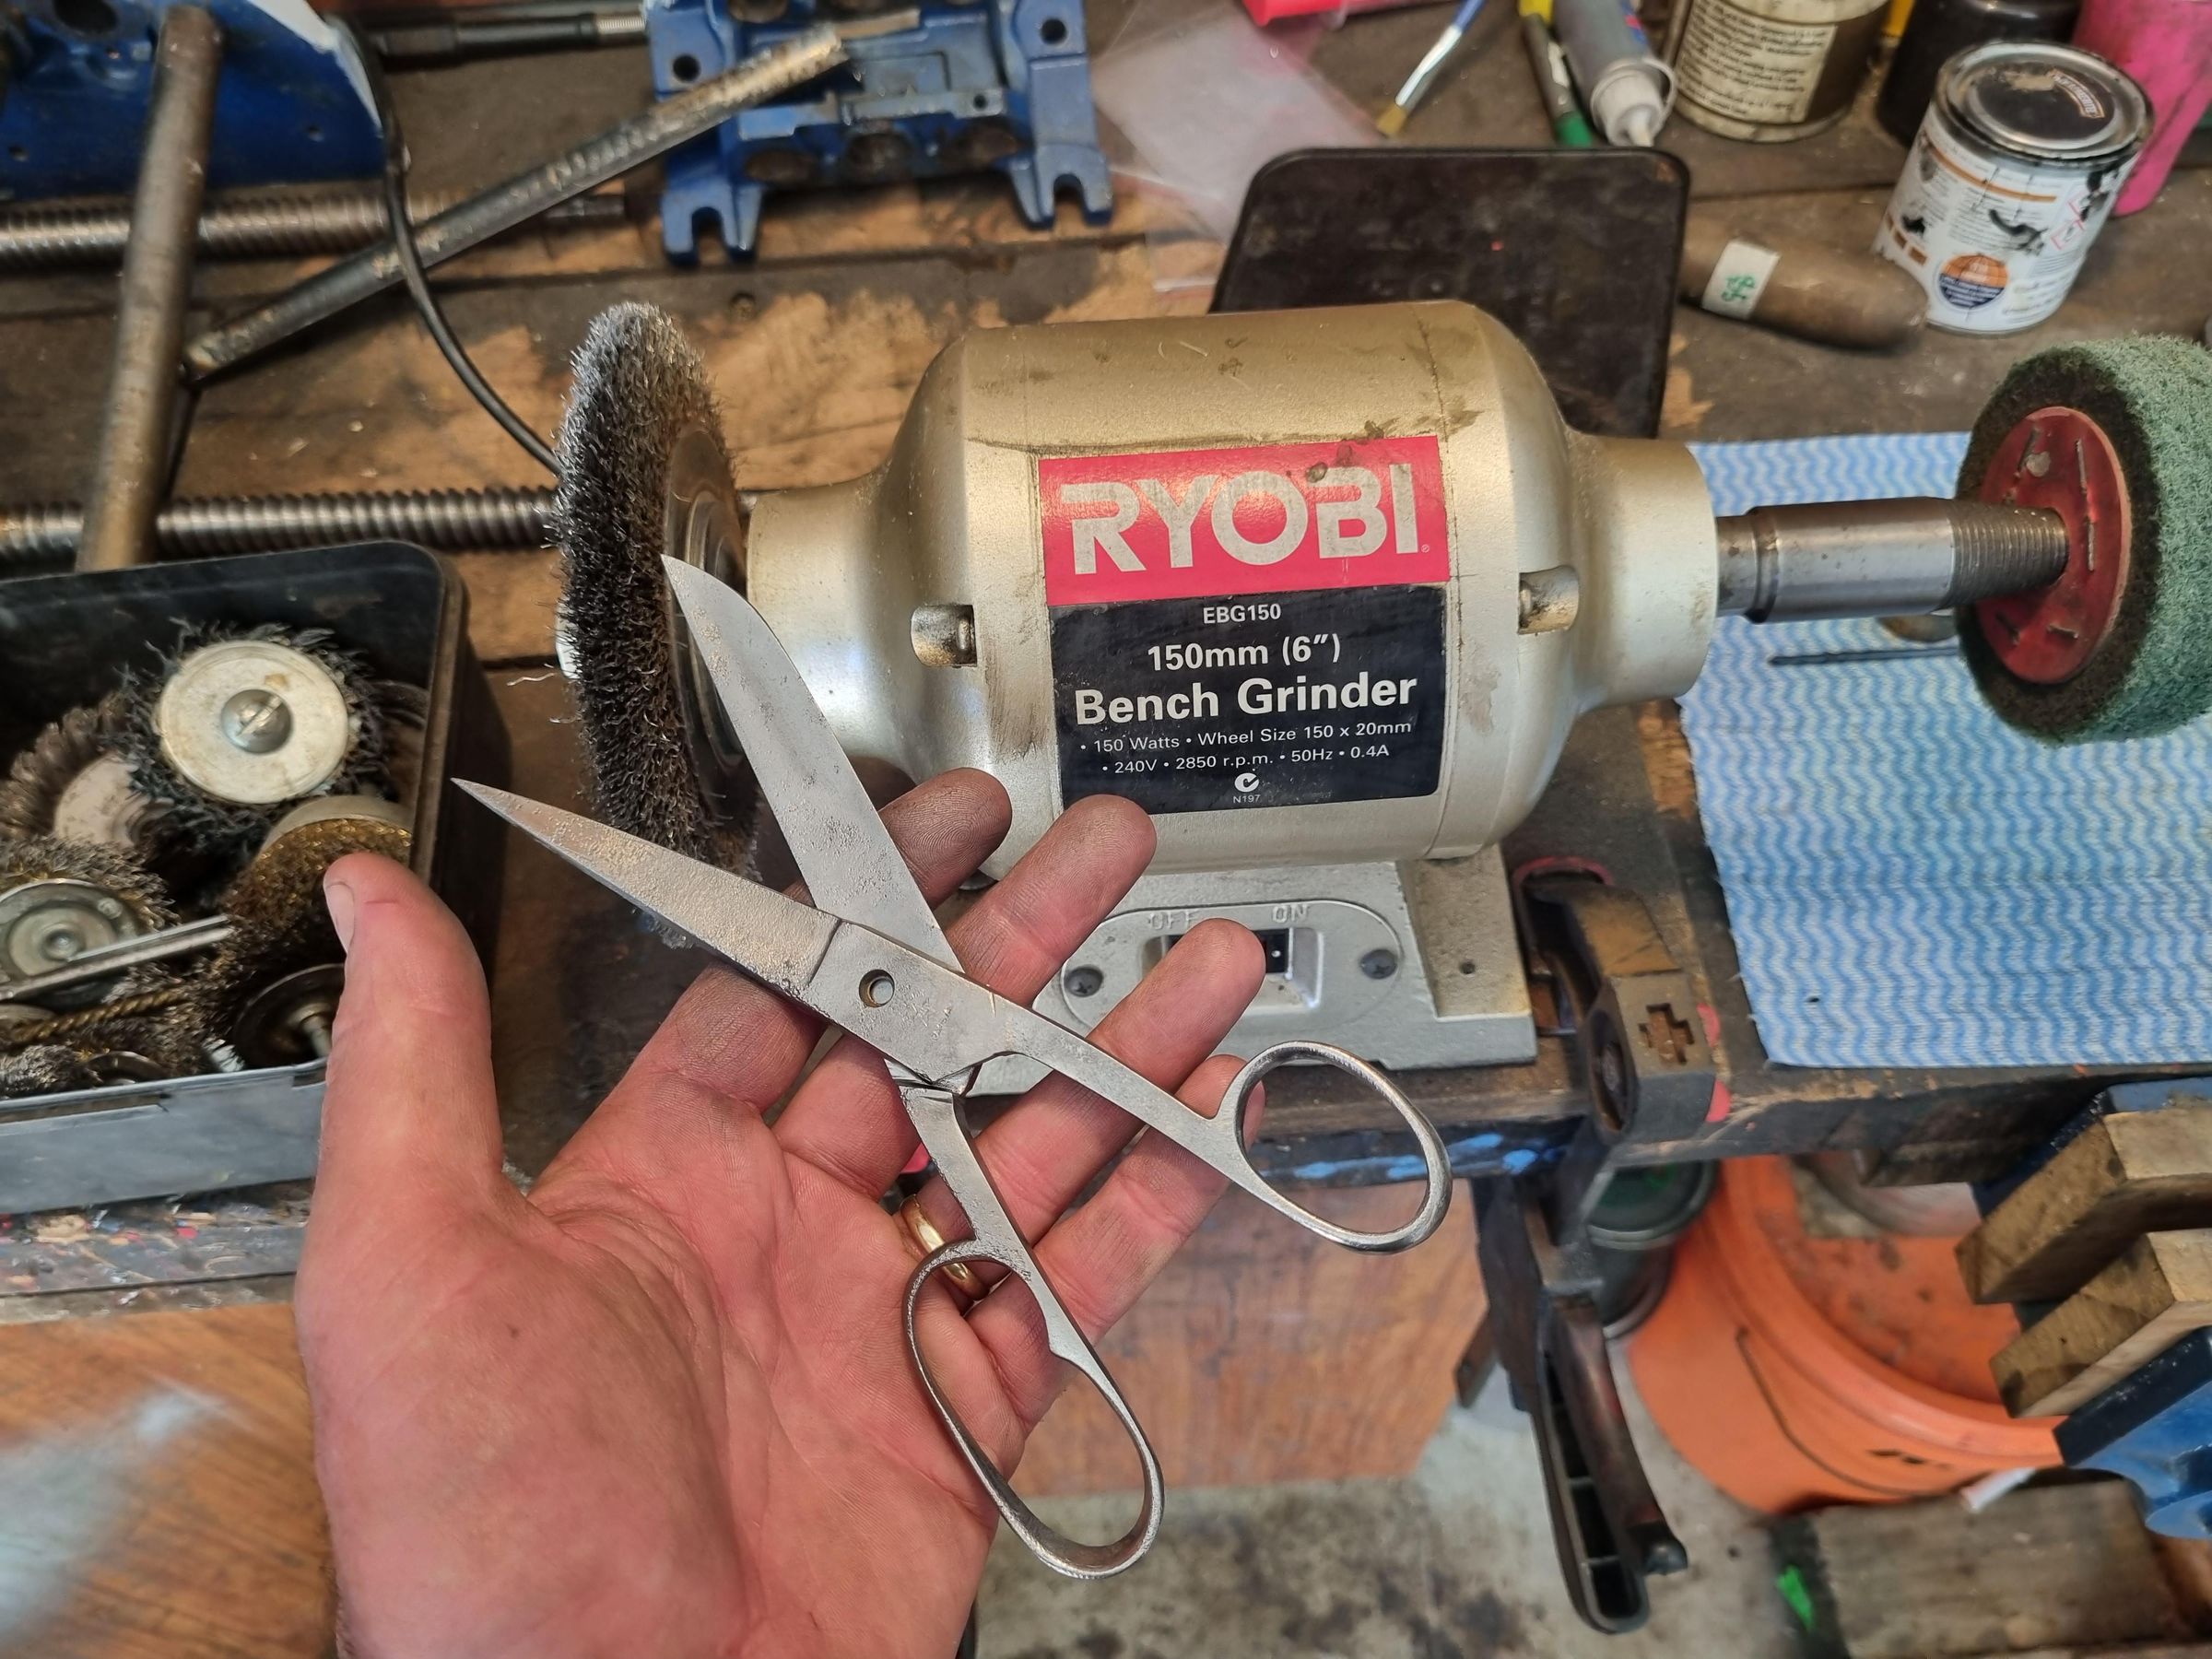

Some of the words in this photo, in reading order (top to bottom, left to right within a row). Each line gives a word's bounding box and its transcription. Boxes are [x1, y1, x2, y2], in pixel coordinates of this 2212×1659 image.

[1060, 464, 1418, 574] RYOBI
[1204, 604, 1280, 623] EBG150
[1148, 643, 1267, 670] 150mm
[1076, 683, 1218, 724] Bench
[1238, 672, 1417, 714] Grinder
[1094, 739, 1123, 752] 150
[1130, 737, 1179, 749] Watts
[1198, 730, 1253, 745] Wheel
[1261, 729, 1295, 741] Size
[1304, 725, 1333, 738] 150
[1340, 727, 1348, 736] x
[1356, 723, 1410, 735] 20mm
[1115, 759, 1157, 772] 240V
[1176, 756, 1216, 769] 2850
[1224, 756, 1273, 768] r.p.m.
[1292, 748, 1333, 761] 50Hz
[1351, 745, 1389, 758] 0.4A
[1233, 794, 1260, 803] N197
[1149, 911, 1198, 930] OFF
[1272, 904, 1310, 924] ON
